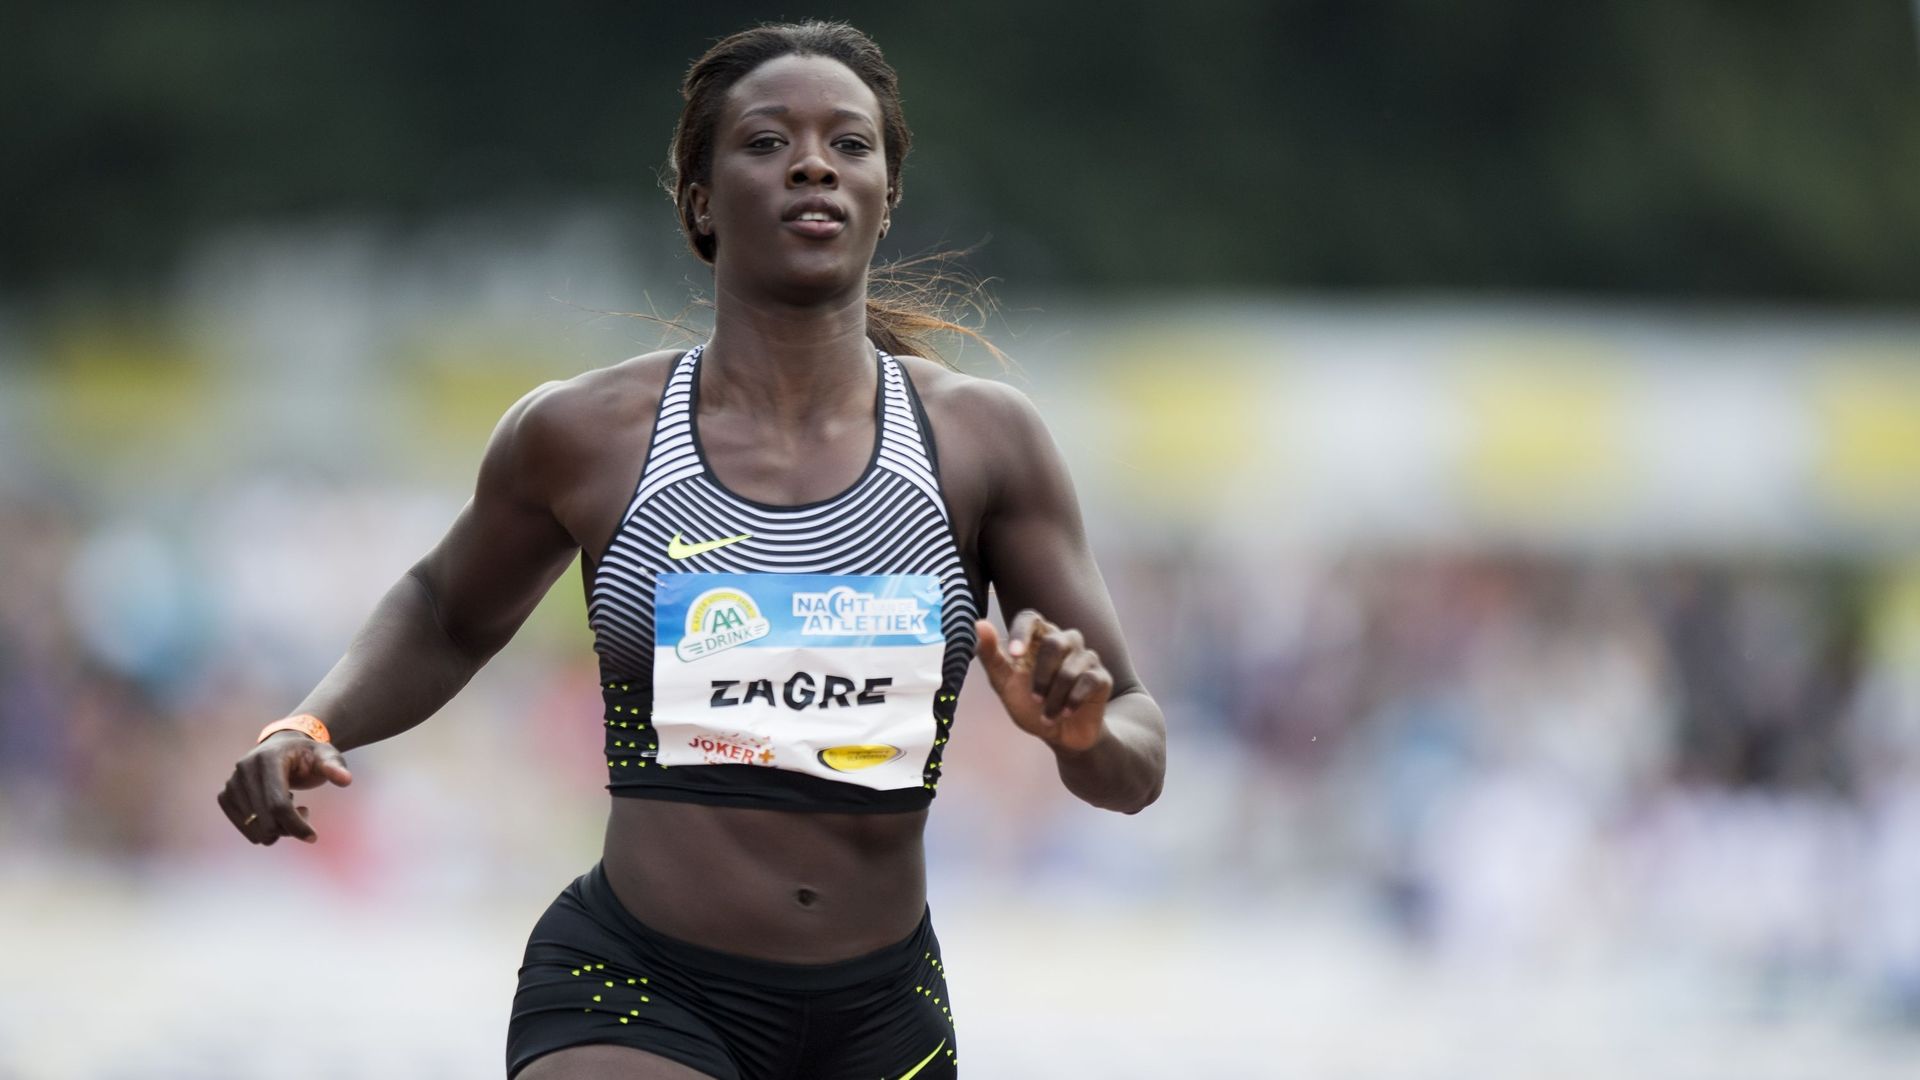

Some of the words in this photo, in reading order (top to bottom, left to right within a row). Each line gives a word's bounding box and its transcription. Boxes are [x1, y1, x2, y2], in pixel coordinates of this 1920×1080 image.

[797, 591, 869, 618] NACHT
[712, 607, 744, 633] AA
[808, 614, 922, 631] ATLETIEK
[704, 626, 752, 651] DRINK
[710, 671, 893, 711] ZAGRE
